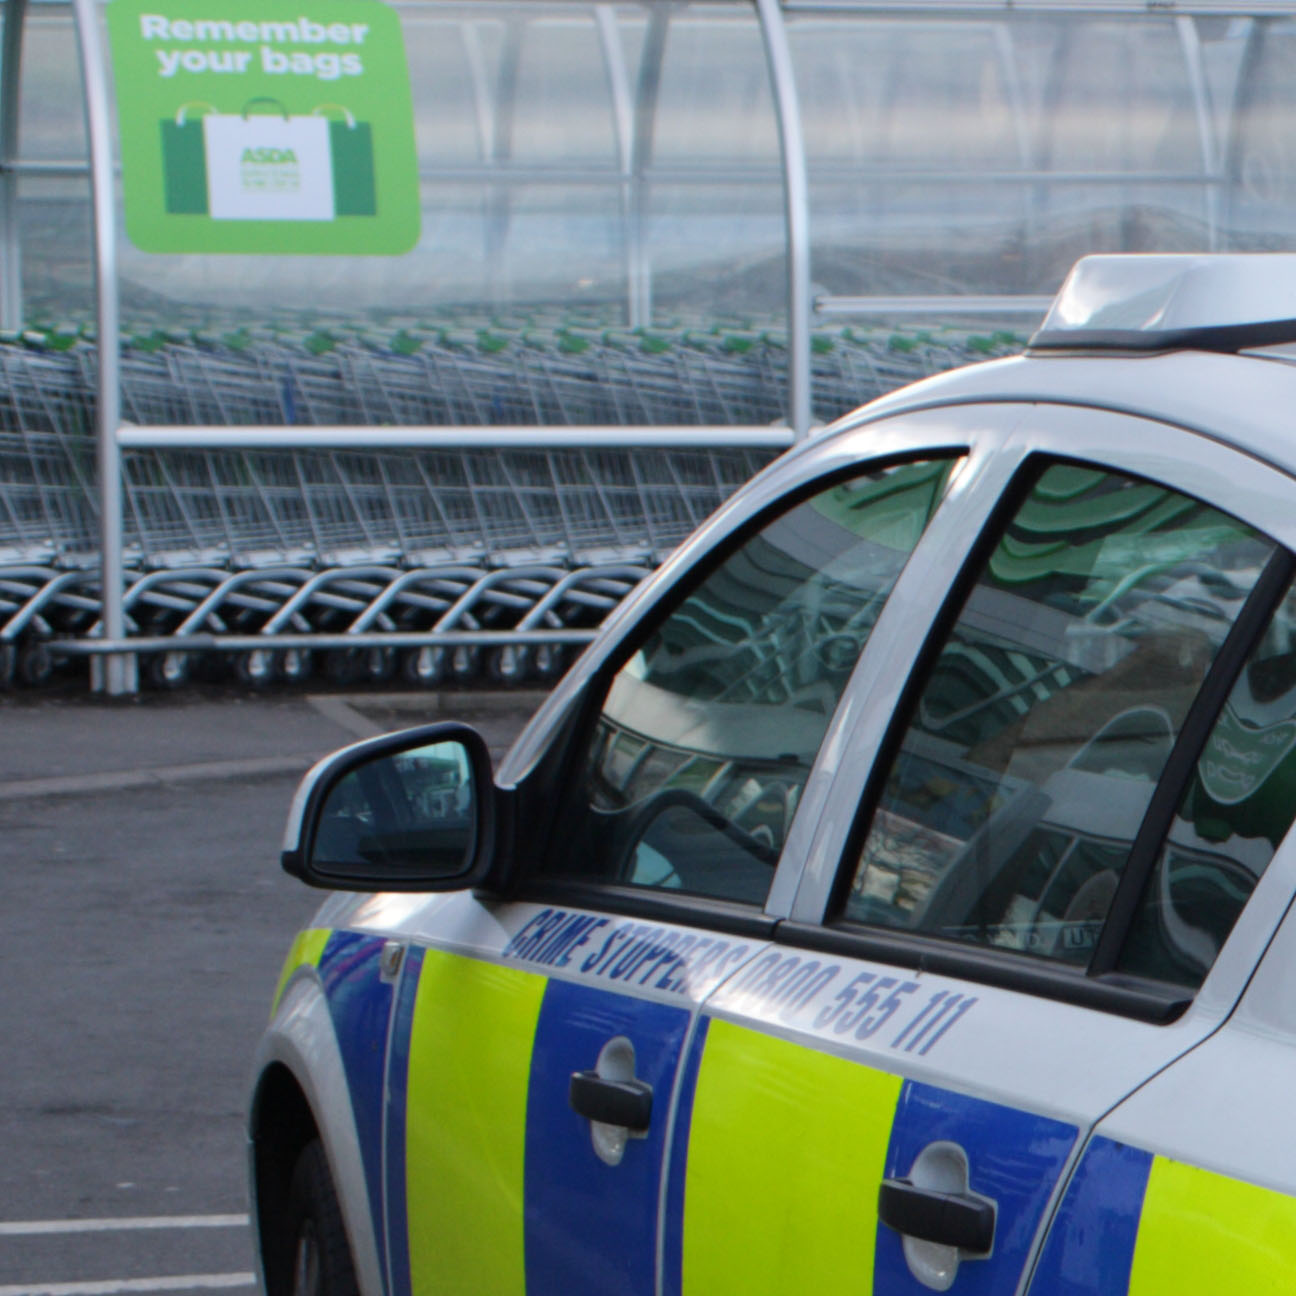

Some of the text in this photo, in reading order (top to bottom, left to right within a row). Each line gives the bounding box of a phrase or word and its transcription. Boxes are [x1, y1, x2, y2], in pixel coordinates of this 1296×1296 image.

[139, 14, 369, 44] Remember
[156, 46, 363, 80] your bags
[241, 147, 298, 163] ASDA
[502, 908, 611, 967] CRIME
[726, 952, 842, 1021] 0800
[812, 971, 922, 1041] 555
[890, 990, 980, 1056] 111
